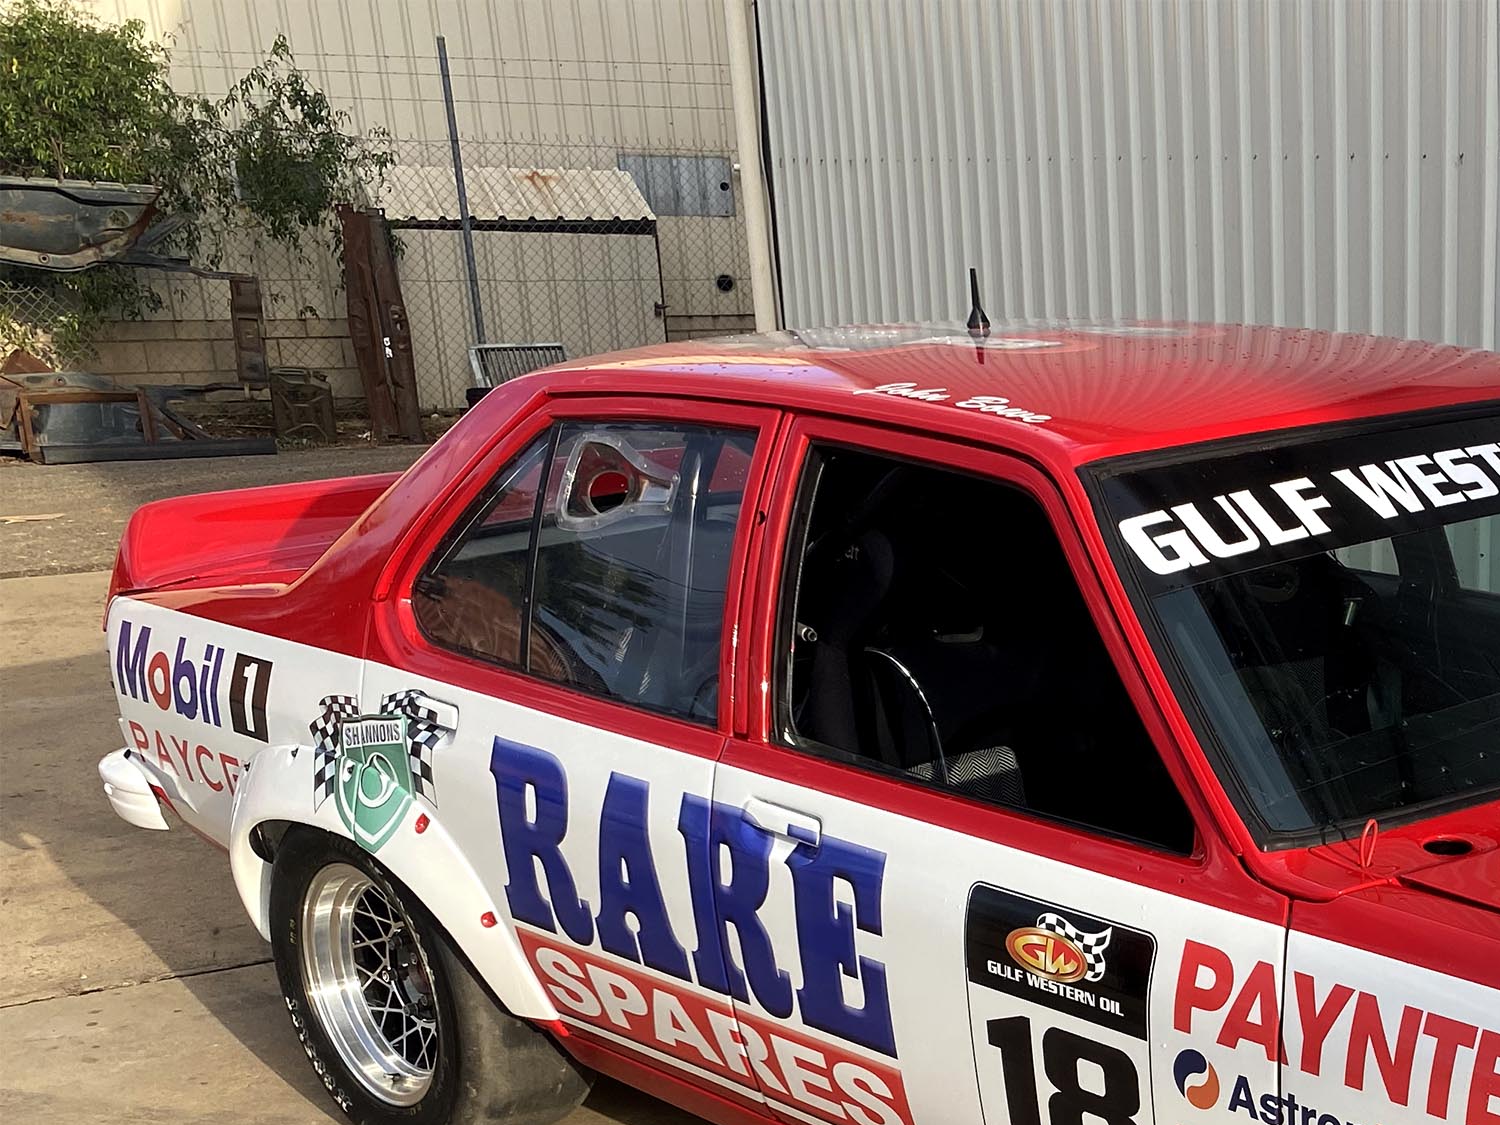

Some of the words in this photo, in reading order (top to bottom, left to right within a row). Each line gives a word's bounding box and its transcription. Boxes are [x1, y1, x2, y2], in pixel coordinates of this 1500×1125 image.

[1118, 477, 1332, 576] GULF
[116, 620, 225, 728] Mobil
[344, 721, 401, 748] SHANNONS
[489, 734, 899, 1060] RARE
[987, 959, 1023, 982] GULF
[1026, 972, 1096, 1008] WESTERN
[1099, 996, 1125, 1017] OIL
